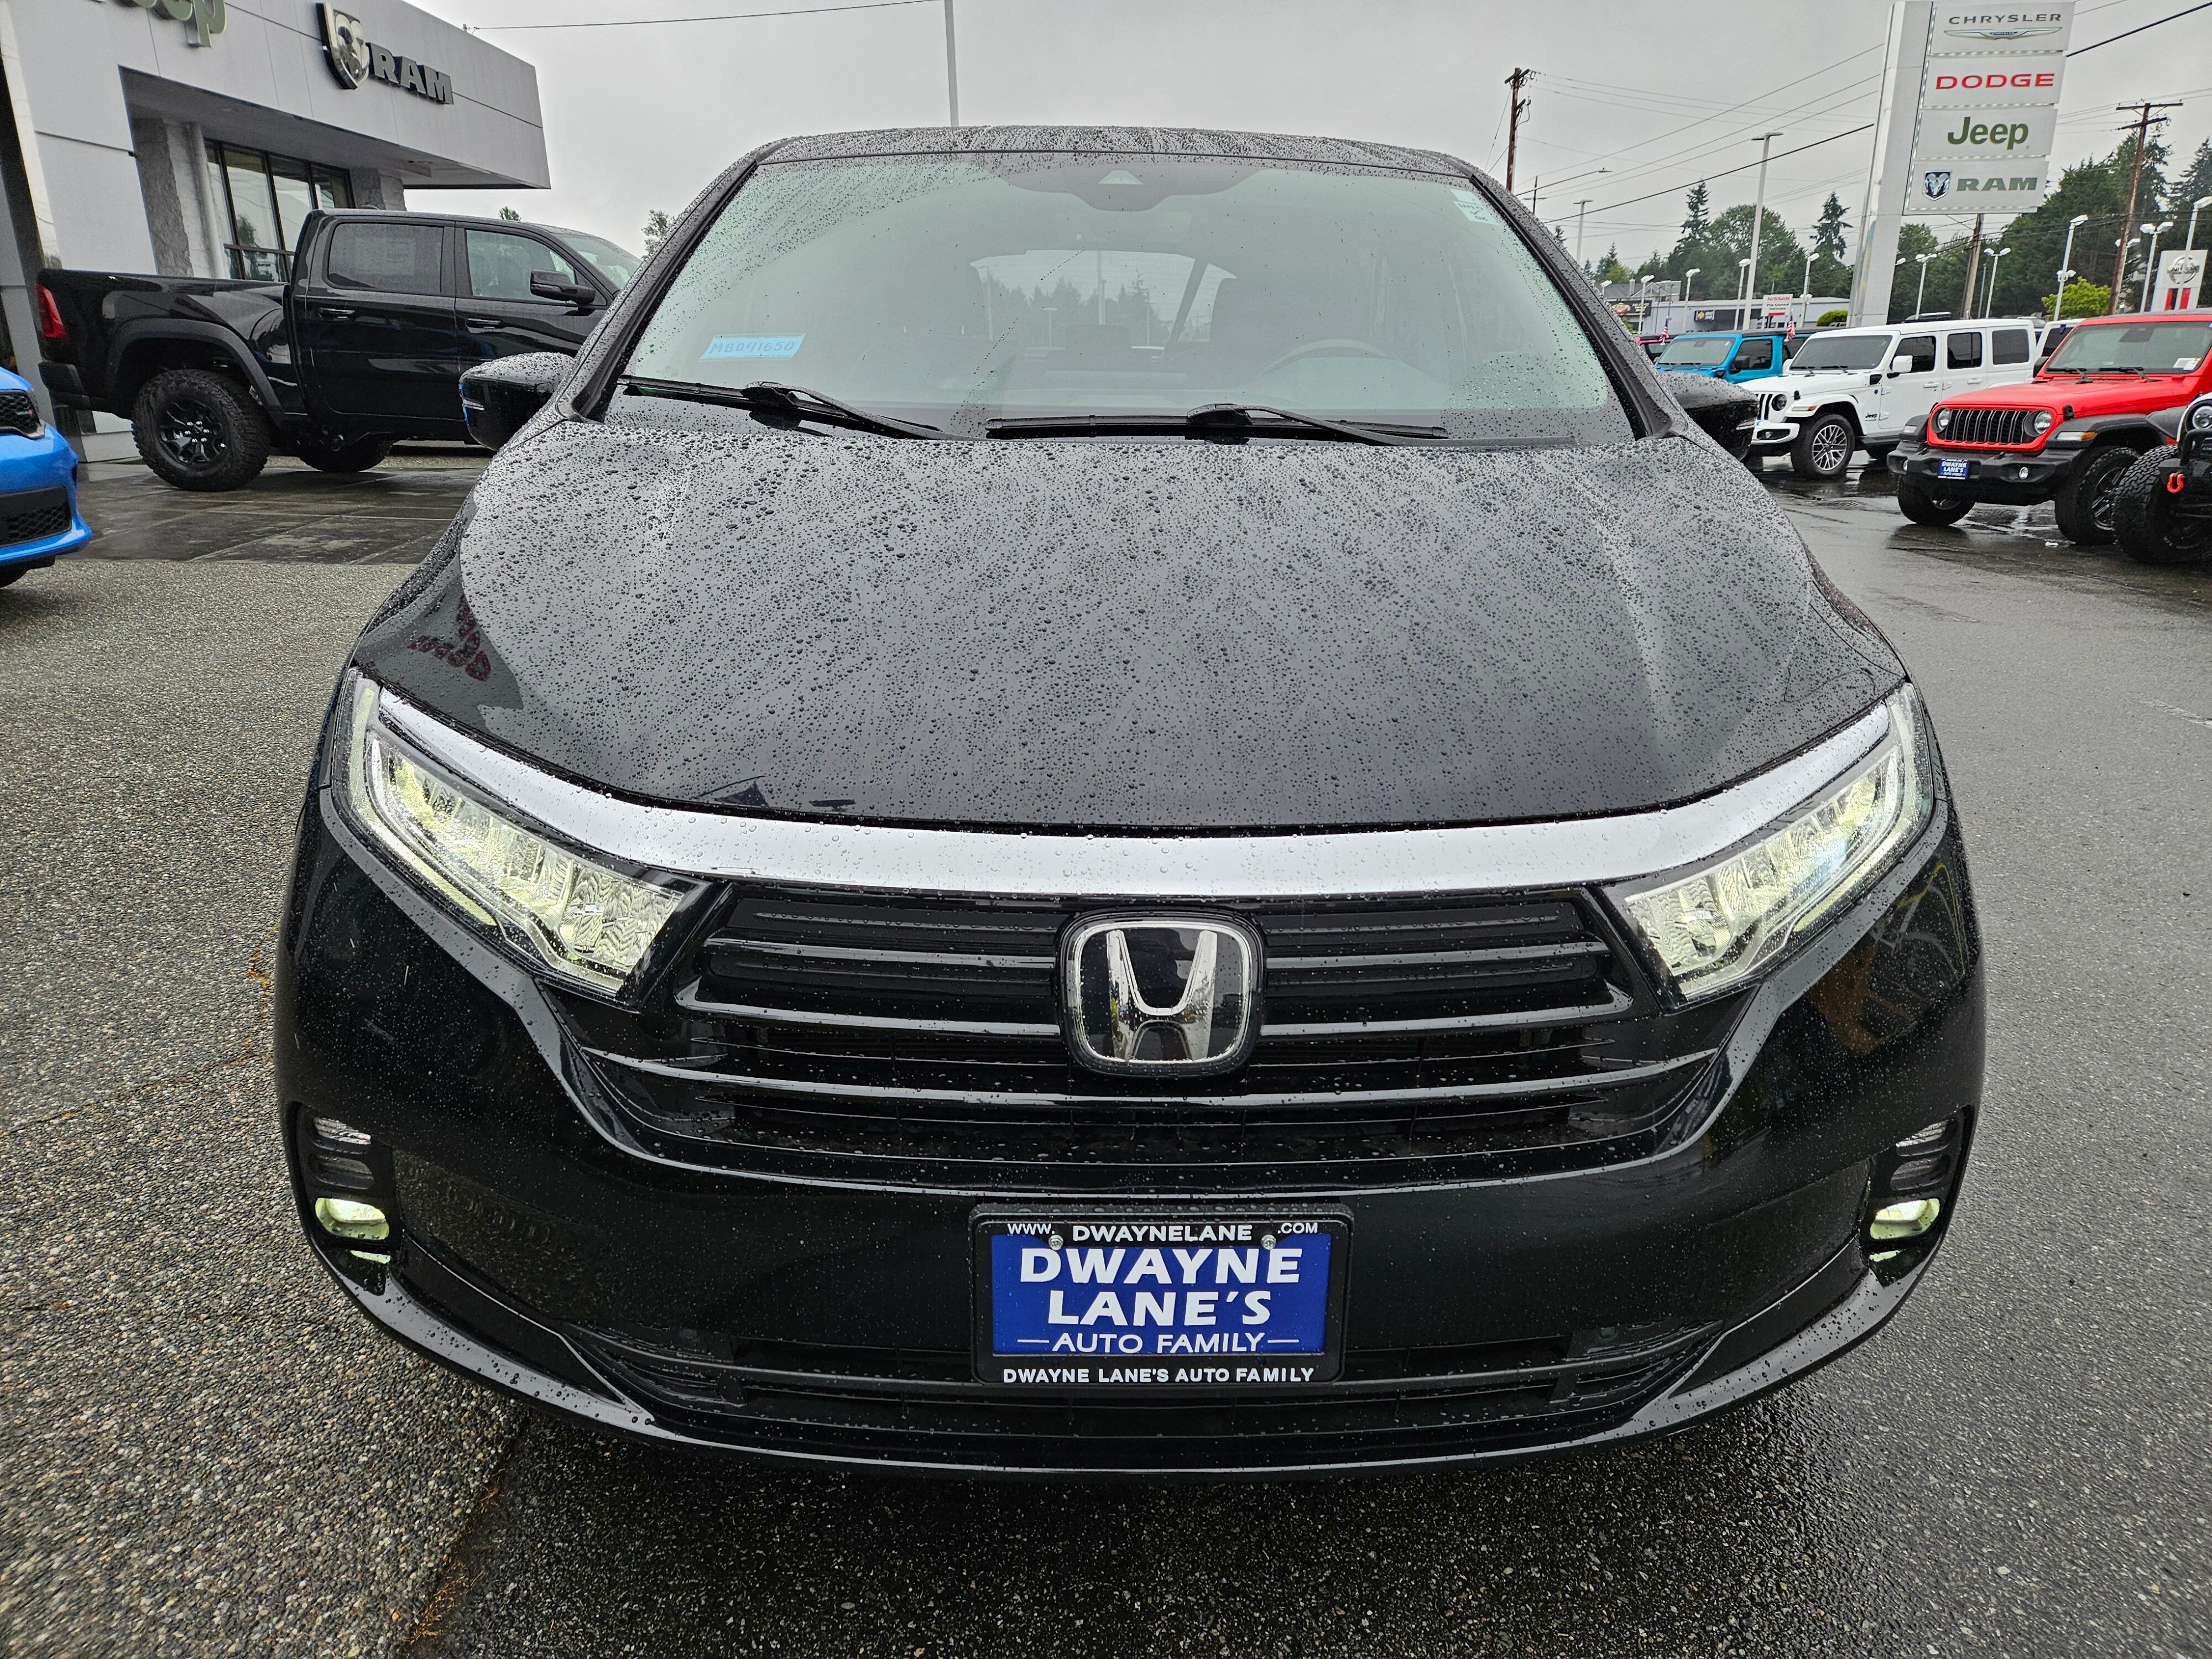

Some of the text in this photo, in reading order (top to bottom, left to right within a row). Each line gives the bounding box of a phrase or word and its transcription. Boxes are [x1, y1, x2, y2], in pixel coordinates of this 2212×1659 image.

[1949, 13, 2062, 24] CHRYSLER
[365, 42, 454, 105] RAM
[1936, 73, 2055, 90] DODGE
[1947, 116, 2028, 150] Jeep
[1957, 177, 2038, 191] RAM
[1073, 1225, 1253, 1242] DWAYNELANE
[1277, 1222, 1318, 1234] .COM
[1020, 1248, 1303, 1284] DWAYNE
[1047, 1290, 1272, 1326] LANE'S
[1052, 1332, 1266, 1353] AUTO FAMILY
[1003, 1368, 1315, 1383] DWAYNE LANE'S AUTO FAMILY
